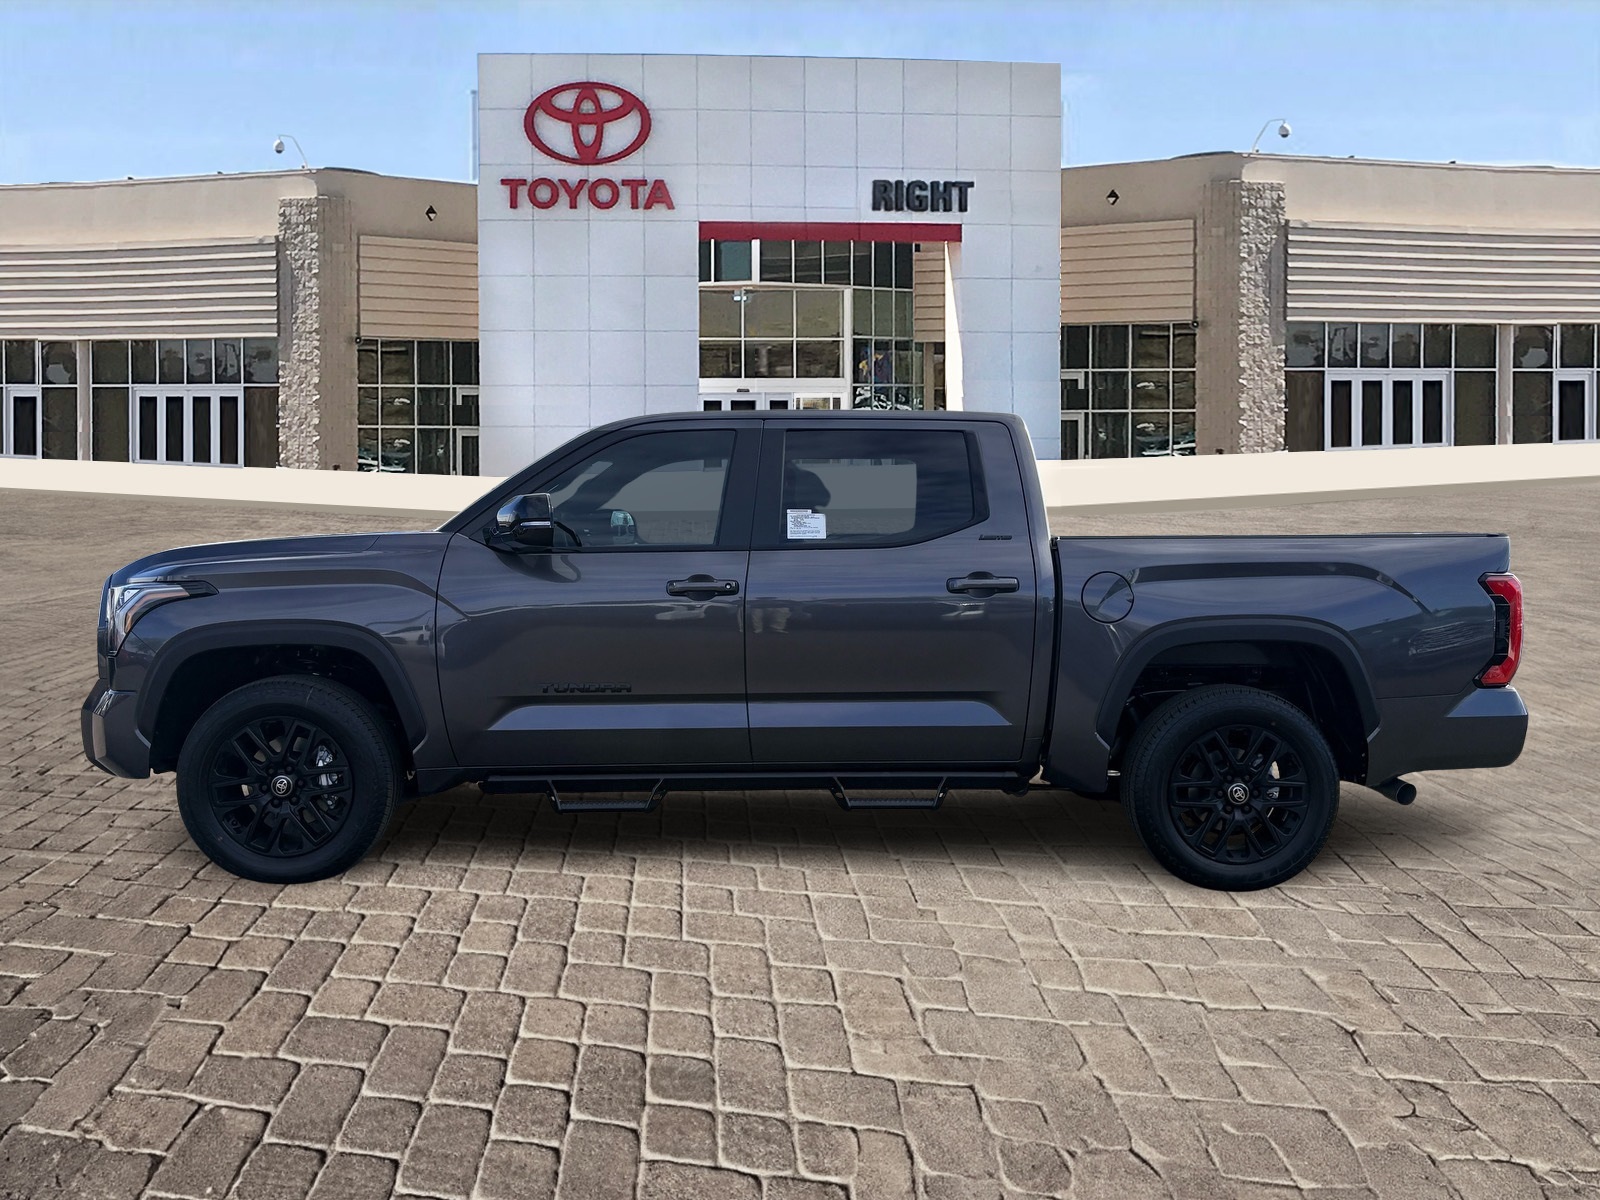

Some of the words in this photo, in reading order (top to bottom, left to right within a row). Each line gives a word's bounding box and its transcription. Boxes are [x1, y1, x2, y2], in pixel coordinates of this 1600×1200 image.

[500, 178, 675, 210] TOYOTA
[872, 179, 975, 212] RIGHT
[539, 682, 632, 694] TUNDRA
